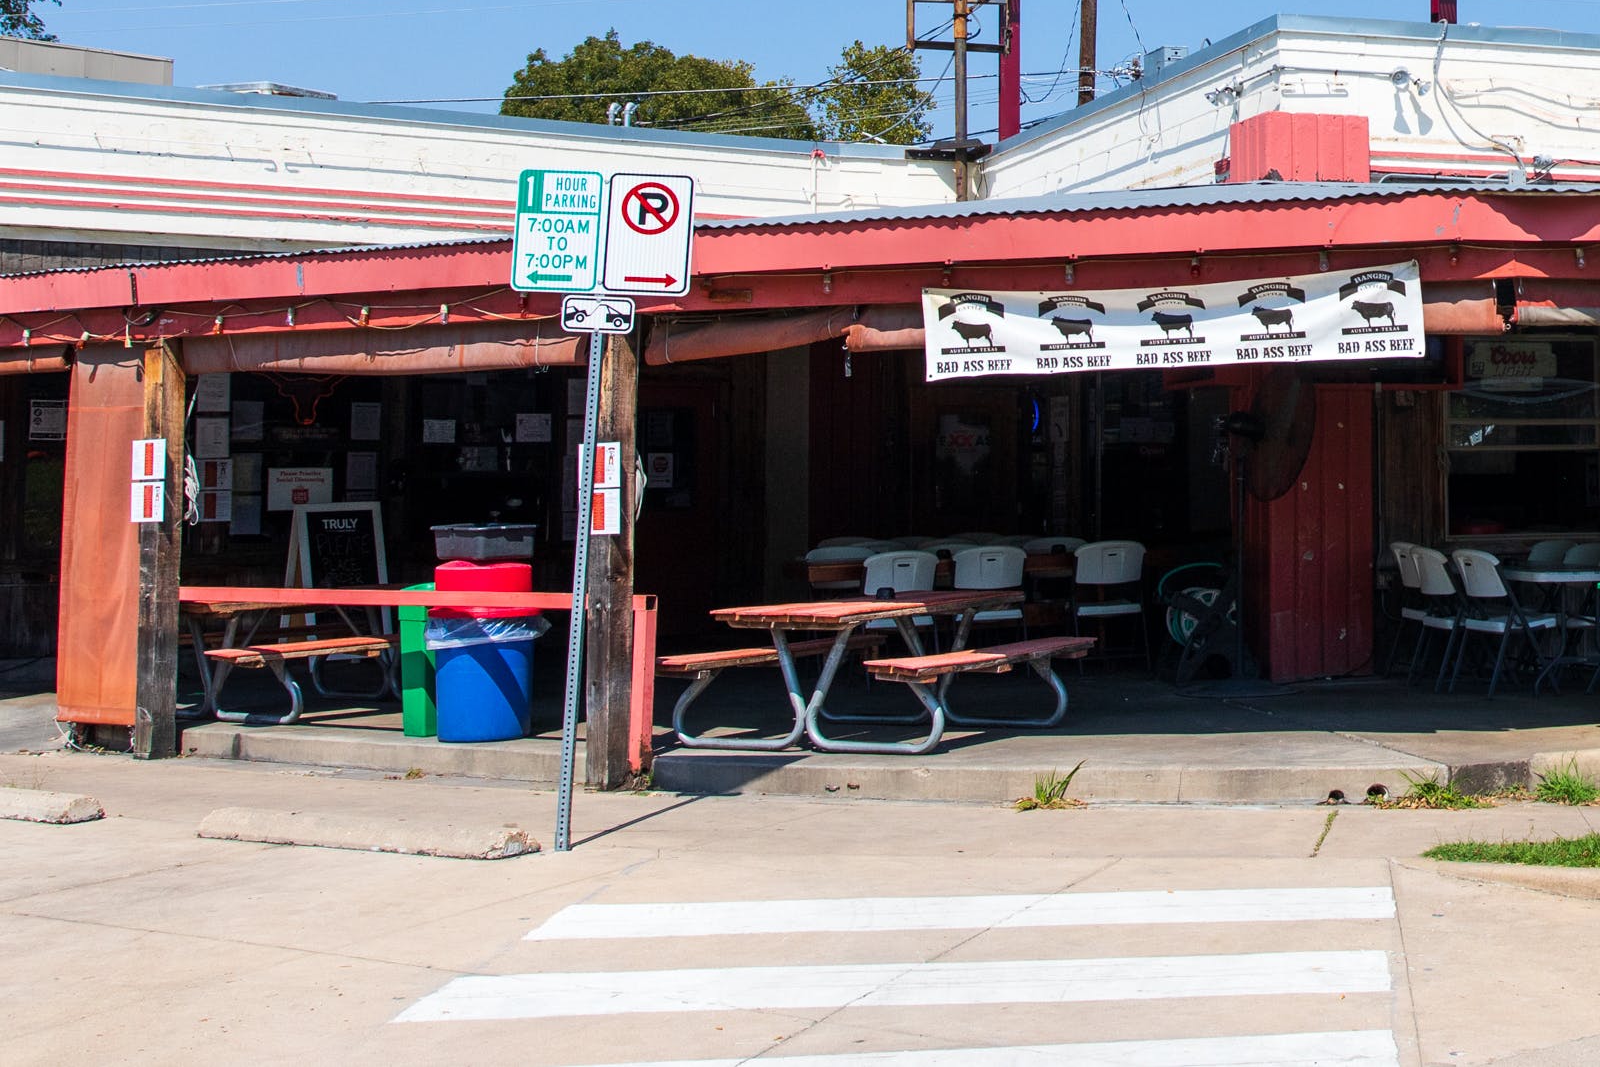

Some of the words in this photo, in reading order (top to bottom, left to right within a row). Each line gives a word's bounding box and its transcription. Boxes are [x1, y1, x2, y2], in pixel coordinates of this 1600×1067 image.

[526, 176, 535, 207] 1
[556, 177, 587, 191] HOUR
[545, 193, 596, 209] PARKING
[527, 218, 590, 234] 7:00AM
[547, 236, 568, 251] TO
[525, 253, 588, 269] 7:00PM
[1236, 348, 1258, 360] BAD
[1263, 346, 1284, 358] ASS
[1288, 344, 1313, 357] BEEF
[1337, 341, 1360, 354] BAD
[1365, 339, 1386, 352] ASS
[1389, 338, 1415, 351] BEEF
[1036, 357, 1058, 369] BAD
[1063, 356, 1083, 368] ASS
[1087, 355, 1112, 367] BEEF
[1136, 353, 1158, 365] BAD
[1163, 351, 1183, 364] ASS
[1187, 350, 1212, 363] BEEF
[1490, 345, 1537, 366] Coors
[937, 361, 958, 374] BAD
[963, 359, 984, 372] ASS
[988, 359, 1012, 371] BEEF
[321, 518, 358, 530] TRULY
